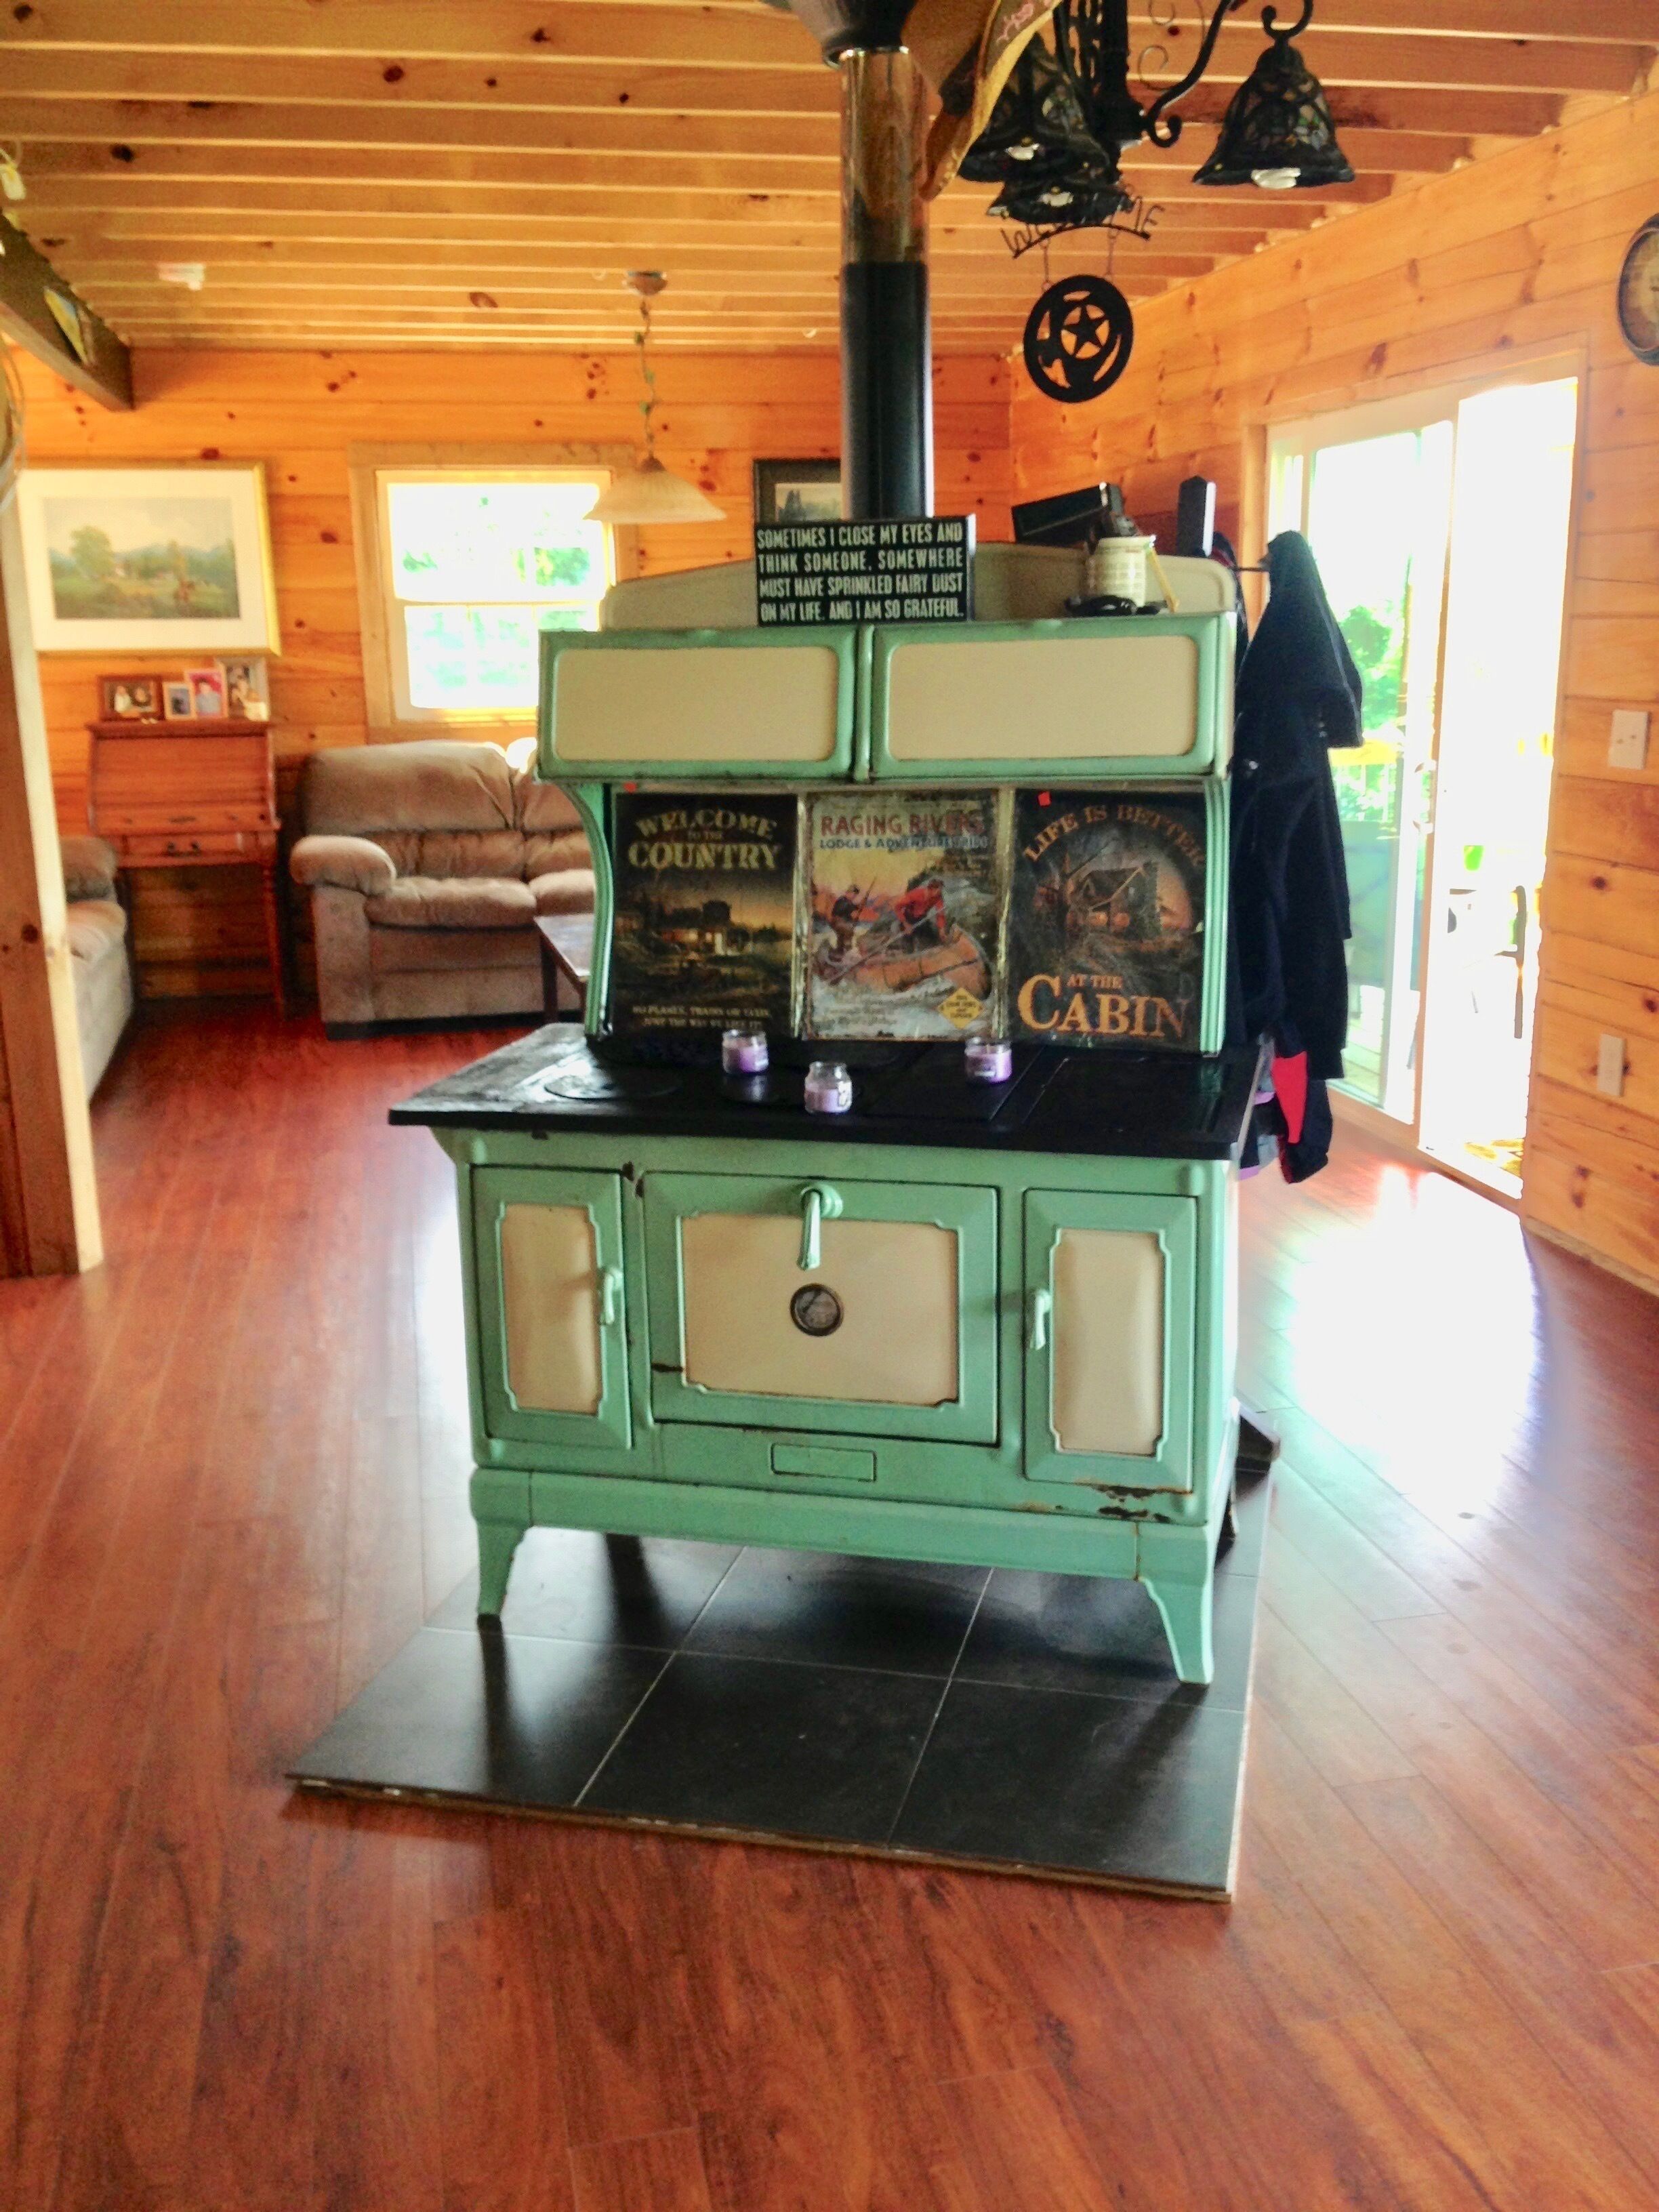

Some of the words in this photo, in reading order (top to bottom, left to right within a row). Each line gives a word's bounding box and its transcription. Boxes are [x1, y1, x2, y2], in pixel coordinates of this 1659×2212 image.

[757, 527, 826, 550] SOMETIMES
[830, 527, 835, 546] I
[839, 525, 876, 546] CLOSE
[880, 525, 898, 544] MY
[903, 523, 933, 544] EYES
[937, 523, 963, 542] AND
[758, 552, 798, 573] THINK
[878, 547, 963, 570] SOMEWHERE
[760, 577, 790, 598] MUST
[794, 576, 824, 596] HAVE
[827, 574, 893, 596] SPRINKLED
[896, 573, 928, 594] FAIRY
[933, 572, 963, 593] DUST
[761, 602, 777, 621] ON
[780, 602, 796, 621] MY
[830, 600, 853, 620] AND
[856, 600, 861, 619] I
[864, 599, 881, 619] AM
[884, 598, 901, 619] SO
[904, 597, 964, 619] GRATEFUL.
[636, 809, 777, 840] WELCOME
[821, 814, 903, 836] RAGING
[909, 812, 985, 836] RIVERS
[1023, 813, 1079, 861] LIFE
[1084, 804, 1107, 823] IS
[1117, 804, 1205, 867] BETTER
[628, 841, 780, 870] COUNTRY
[820, 838, 860, 849] LODGE
[1067, 974, 1087, 987] AT
[1090, 975, 1124, 989] THE
[1017, 972, 1191, 1038] CABIN
